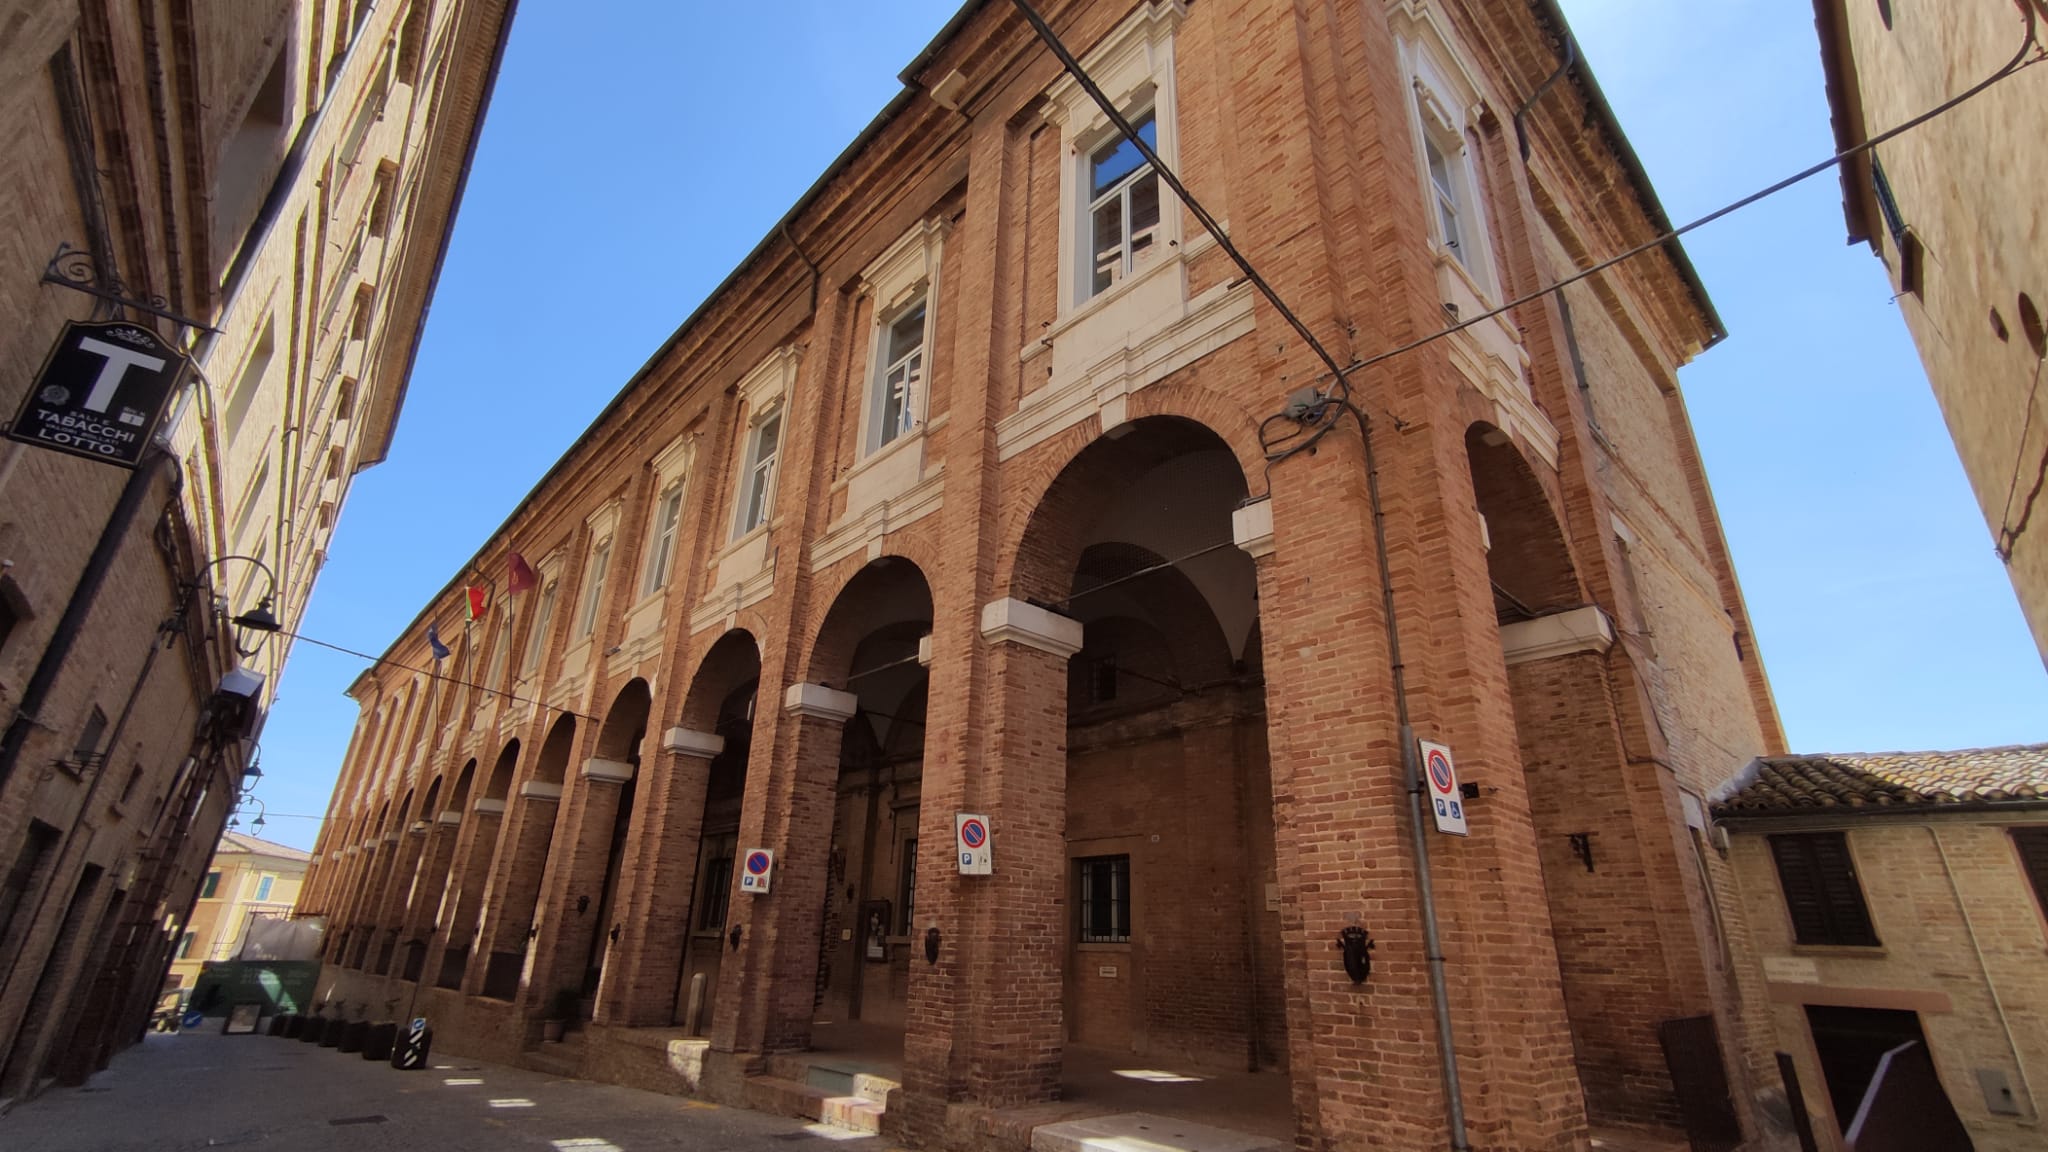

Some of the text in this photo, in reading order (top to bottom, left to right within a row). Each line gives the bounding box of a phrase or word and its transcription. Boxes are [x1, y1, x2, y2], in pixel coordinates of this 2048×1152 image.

[79, 336, 166, 414] T
[37, 408, 136, 443] TABACCHI
[70, 411, 98, 422] SALI
[38, 428, 116, 454] LOTTO
